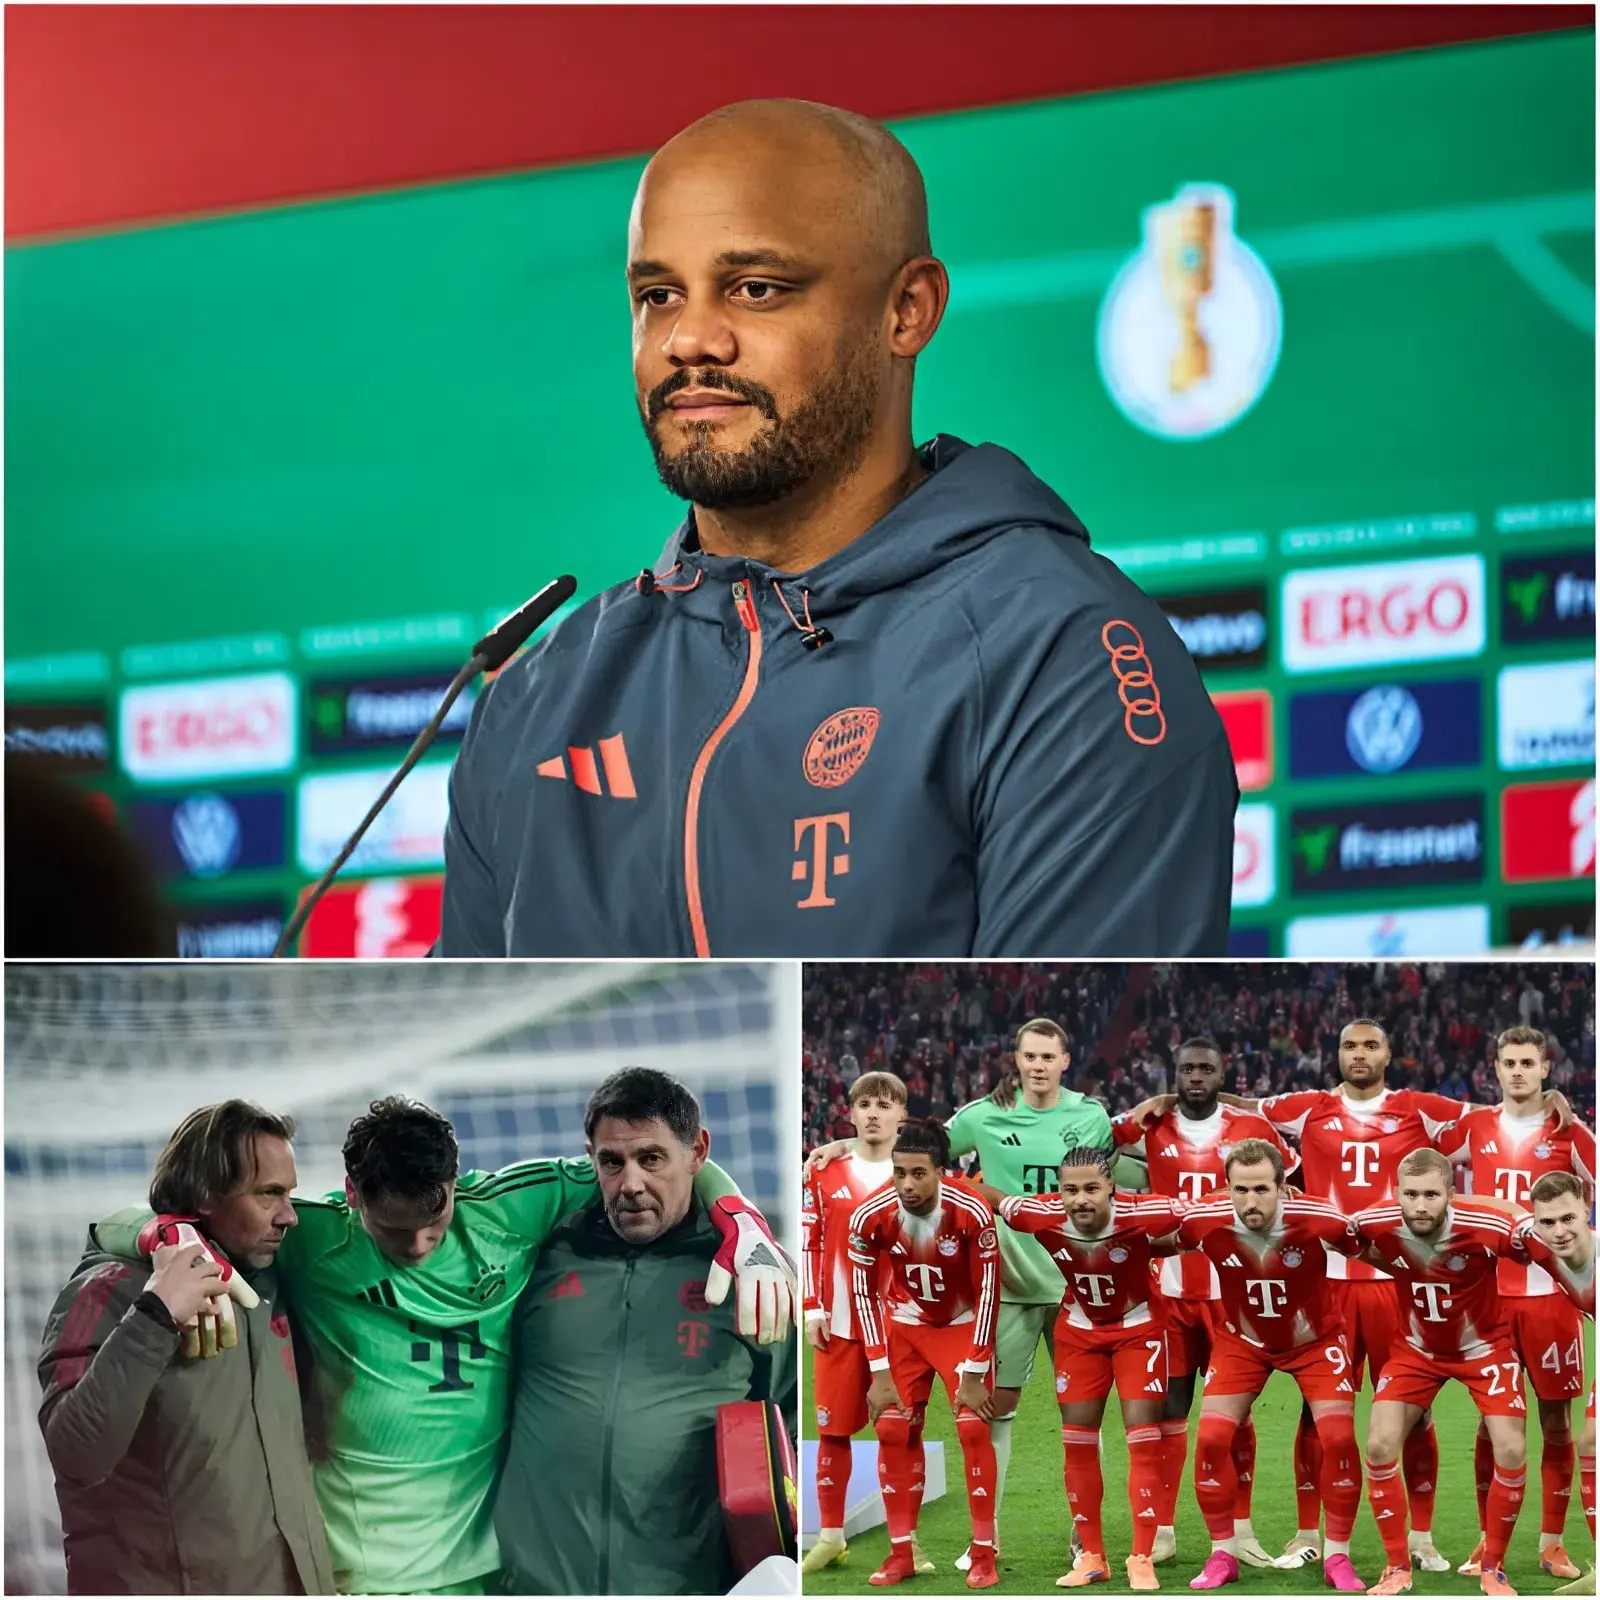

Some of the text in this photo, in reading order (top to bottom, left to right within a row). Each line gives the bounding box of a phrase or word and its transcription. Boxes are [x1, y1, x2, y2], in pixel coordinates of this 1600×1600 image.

[1302, 579, 1469, 648] ERGO
[792, 812, 850, 908] T
[1341, 1141, 1380, 1187] T
[905, 1264, 946, 1302] T
[1074, 1273, 1115, 1306] T
[1246, 1279, 1287, 1317] T
[1411, 1281, 1451, 1321] T
[677, 1320, 710, 1358] T
[1145, 1341, 1161, 1373] 7
[1541, 1338, 1579, 1374] 44
[1324, 1346, 1346, 1375] 9
[1480, 1362, 1520, 1395] 27
